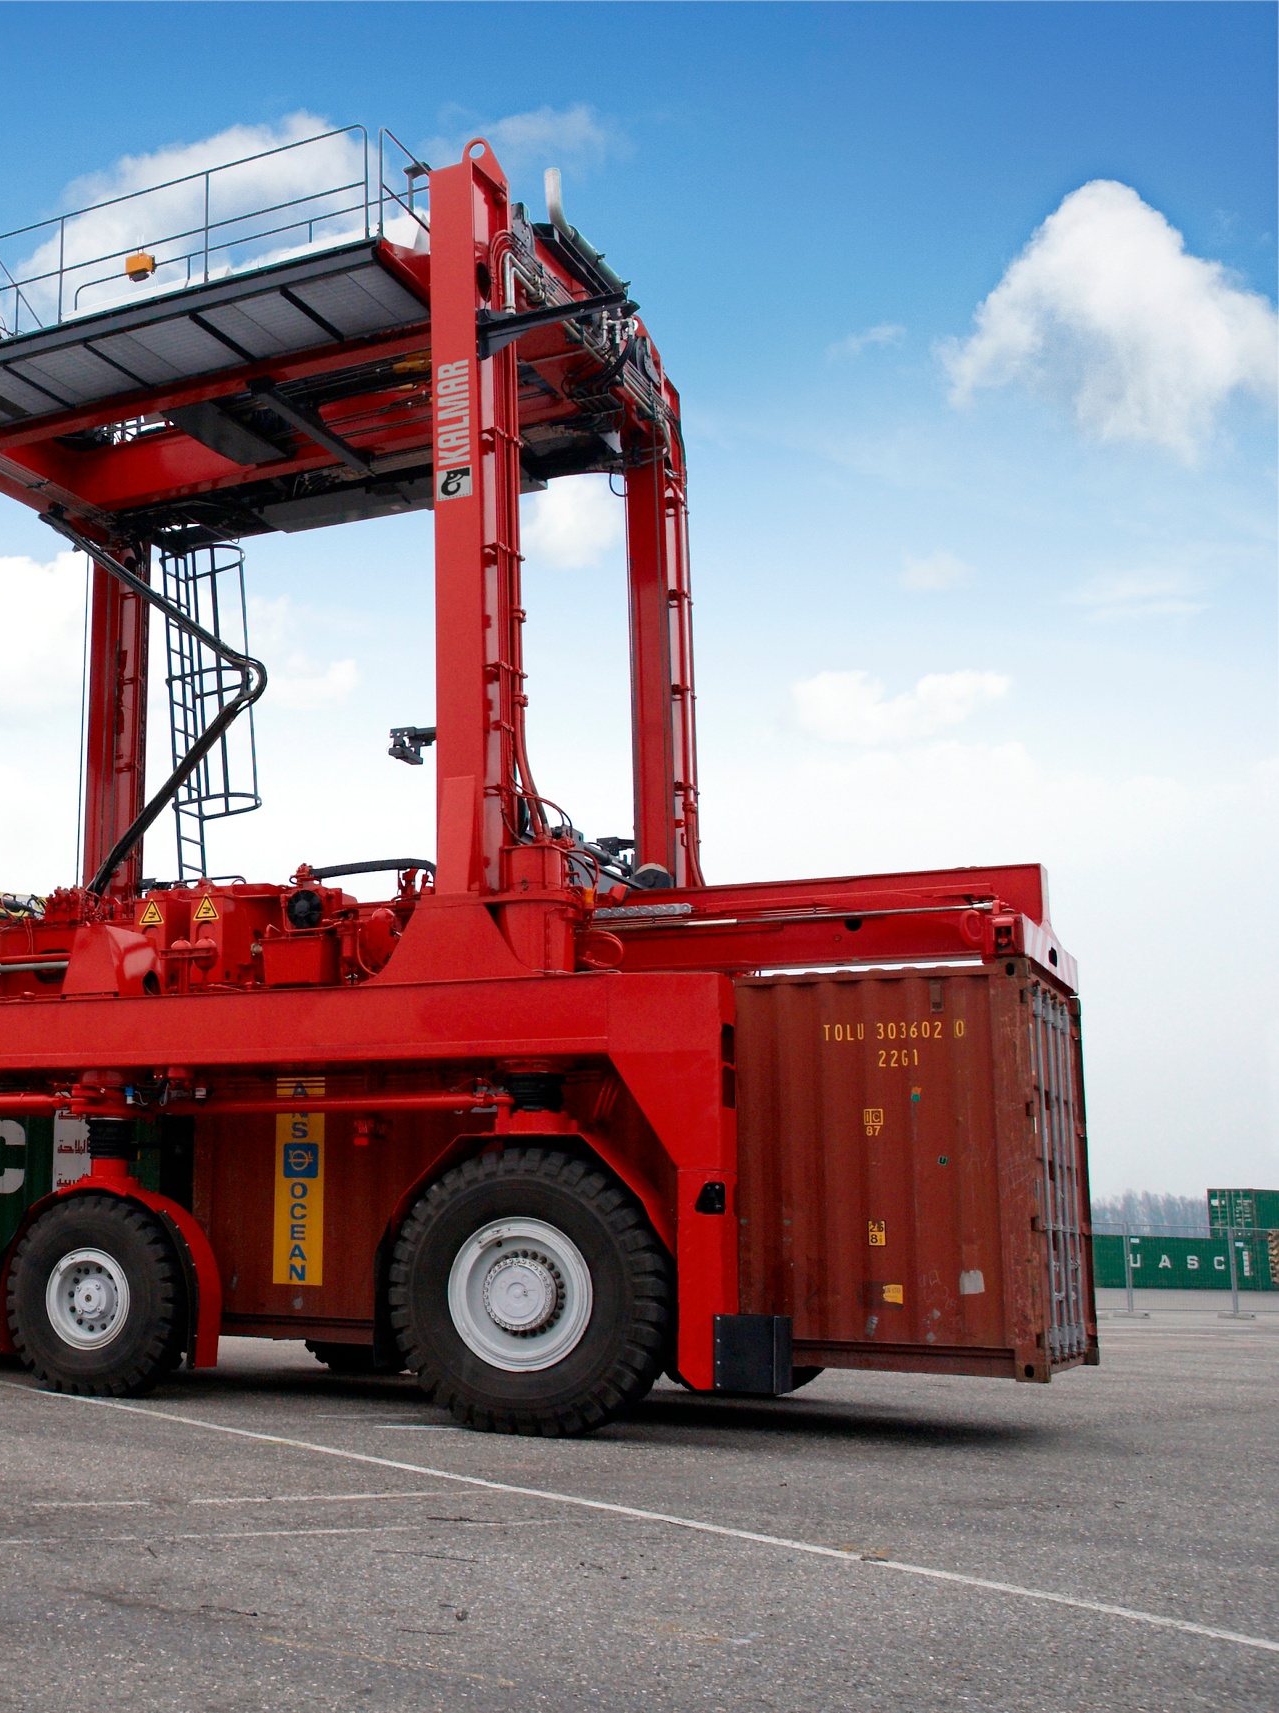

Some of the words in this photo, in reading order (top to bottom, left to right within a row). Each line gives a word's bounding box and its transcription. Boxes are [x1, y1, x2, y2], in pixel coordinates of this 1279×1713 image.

[437, 359, 470, 467] KALMAR
[823, 1023, 864, 1041] TOLU
[876, 1021, 942, 1040] 303602
[955, 1020, 964, 1037] 0
[878, 1049, 919, 1067] 22G1
[290, 1082, 309, 1139] AS
[865, 1125, 881, 1136] 87
[288, 1181, 309, 1282] OCEAN
[1129, 1253, 1226, 1270] UASC
